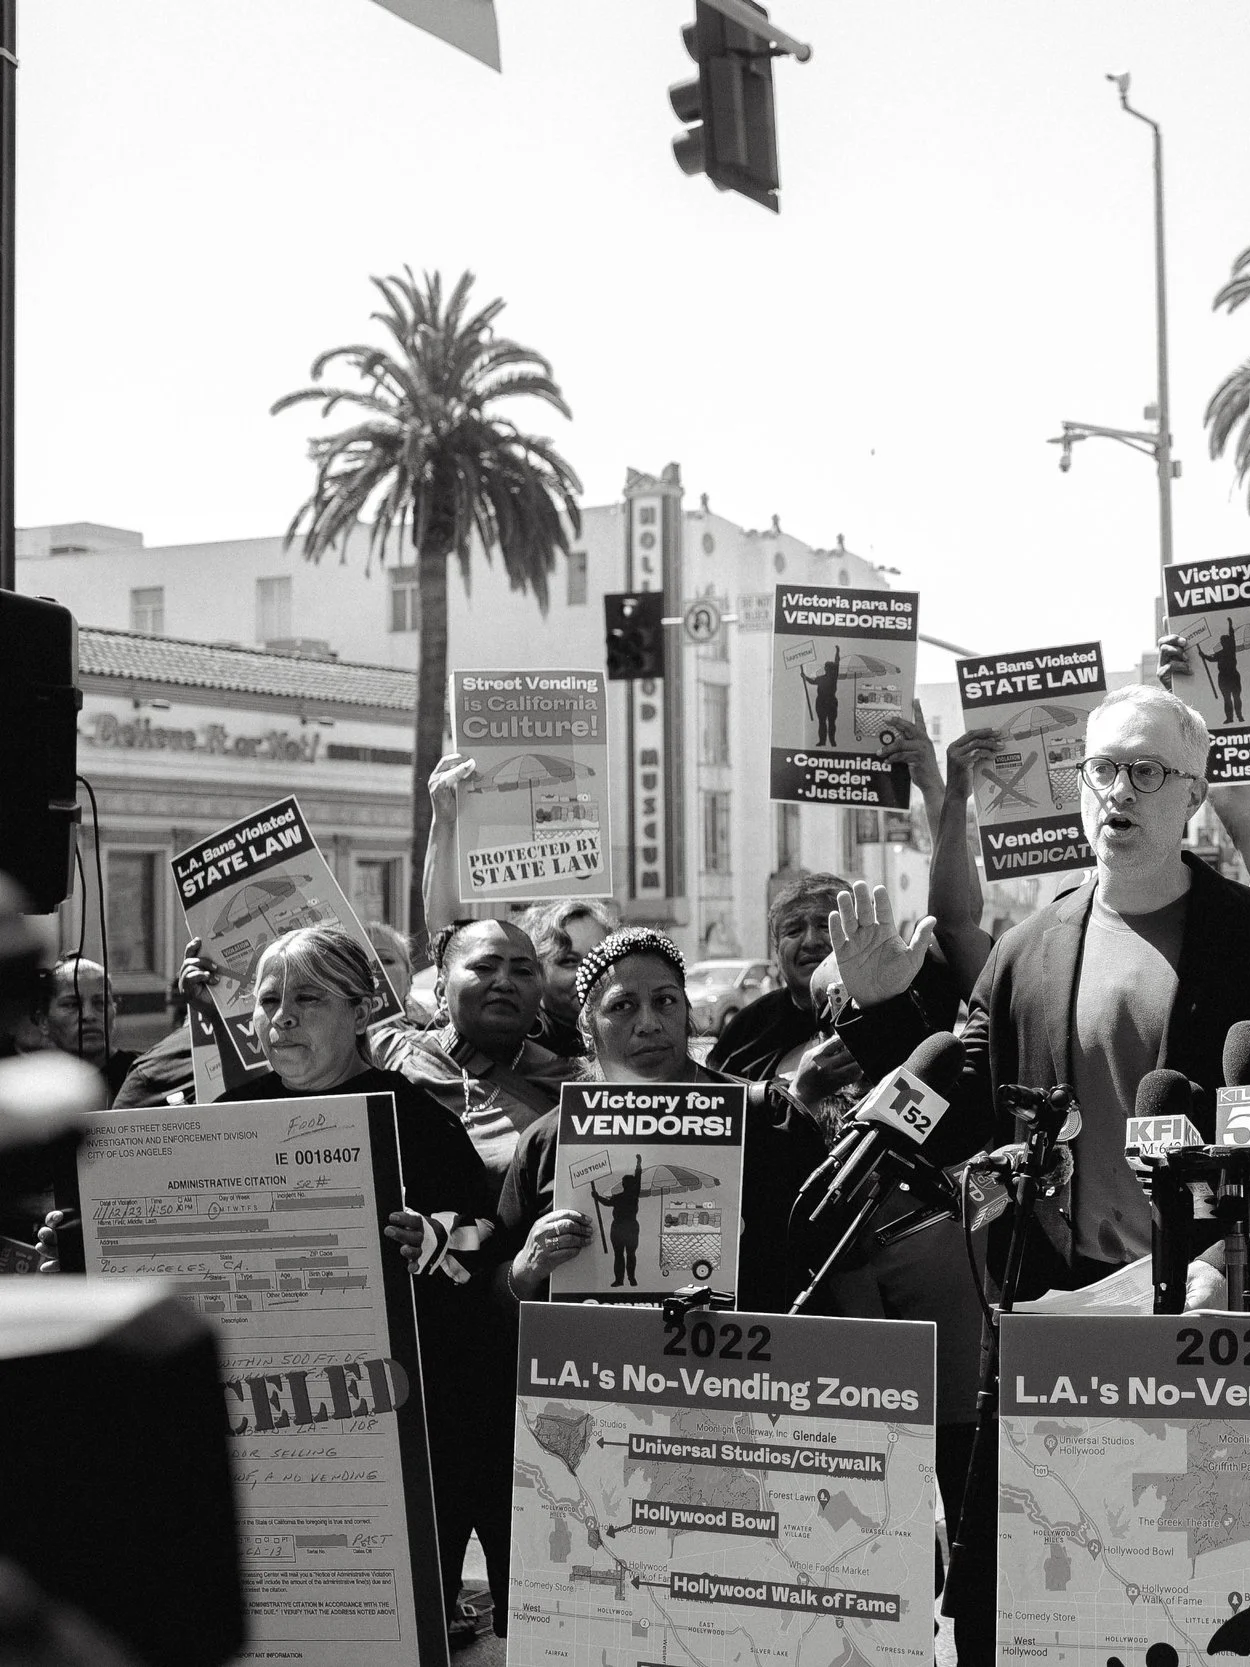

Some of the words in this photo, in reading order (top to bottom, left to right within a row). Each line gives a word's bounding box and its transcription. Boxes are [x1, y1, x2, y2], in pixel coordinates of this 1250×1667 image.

[852, 598, 888, 612] para
[890, 599, 912, 612] los
[784, 611, 912, 630] VENDEDORES!
[963, 664, 994, 679] L.A.
[996, 659, 1033, 675] Bans
[1034, 650, 1097, 670] Violated
[462, 677, 522, 691] Street
[526, 676, 599, 693] Vending
[965, 675, 1043, 699] STATE
[1046, 666, 1099, 689] LAW
[463, 697, 482, 712] is
[487, 695, 598, 712] California
[462, 715, 598, 738] Culture!
[815, 770, 871, 785] Poder
[805, 785, 879, 802] Justicia
[178, 858, 202, 878] L.A.
[202, 838, 236, 864] Bans
[235, 808, 295, 844] Violated
[988, 826, 1079, 850] Vendors
[469, 842, 570, 868] PROTECTED
[577, 837, 599, 852] BY
[182, 851, 248, 898] STATE
[249, 825, 303, 865] LAW
[472, 861, 546, 887] STATE
[553, 852, 600, 875] LAW
[582, 1091, 680, 1113] Victory
[685, 1092, 724, 1109] for
[118, 1125, 128, 1134] OF
[130, 1124, 160, 1133] STREET
[162, 1122, 201, 1132] SERVICES
[571, 1115, 732, 1136] VENDORS!
[903, 1106, 931, 1135] 52
[1130, 1119, 1181, 1142] KFI
[87, 1137, 145, 1148] INVESTIGATION
[146, 1136, 161, 1145] AND
[163, 1133, 222, 1144] ENFORCEMENT
[224, 1131, 258, 1141] DIVISION
[88, 1151, 104, 1159] CITY
[107, 1150, 117, 1158] OF
[119, 1149, 134, 1158] LOS
[136, 1148, 173, 1157] ANGELES
[275, 1152, 289, 1165] IE
[295, 1147, 361, 1165] 0018407
[168, 1177, 242, 1190] ADMINISTRATIVE
[244, 1175, 287, 1187] CITATION
[663, 1322, 772, 1361] 2022
[530, 1358, 615, 1389] L.A.'s
[623, 1364, 811, 1411] No-Vending
[816, 1377, 919, 1411] Zones
[1017, 1376, 1119, 1405] L.A.'s
[793, 1430, 837, 1444] Glendale
[1059, 1437, 1099, 1445] Universal
[1102, 1437, 1135, 1446] Studios
[632, 1437, 717, 1459] Universal
[721, 1444, 883, 1473] Studios/Citywalk
[1060, 1447, 1105, 1456] Hollywood
[1208, 1462, 1240, 1472] Griffith
[635, 1504, 728, 1528] Hollywood
[731, 1511, 776, 1532] Bowl
[1139, 1517, 1155, 1527] The
[1157, 1518, 1185, 1527] Greek
[1187, 1518, 1220, 1528] Theatre
[1104, 1546, 1149, 1557] Hollywood
[1152, 1547, 1174, 1556] Bowl
[674, 1575, 767, 1600] Hollywood
[772, 1586, 817, 1606] Walk
[822, 1591, 843, 1609] of
[846, 1594, 897, 1614] Fame
[1142, 1584, 1189, 1595] Hollywood
[1142, 1595, 1164, 1605] Walk
[1166, 1595, 1175, 1605] of
[1177, 1596, 1202, 1605] Fame
[1017, 1611, 1051, 1622] Comedy
[1053, 1612, 1076, 1622] Store
[1014, 1636, 1035, 1646] West
[1105, 1636, 1148, 1644] HOLLYWOOD
[1002, 1646, 1048, 1657] Hollywood
